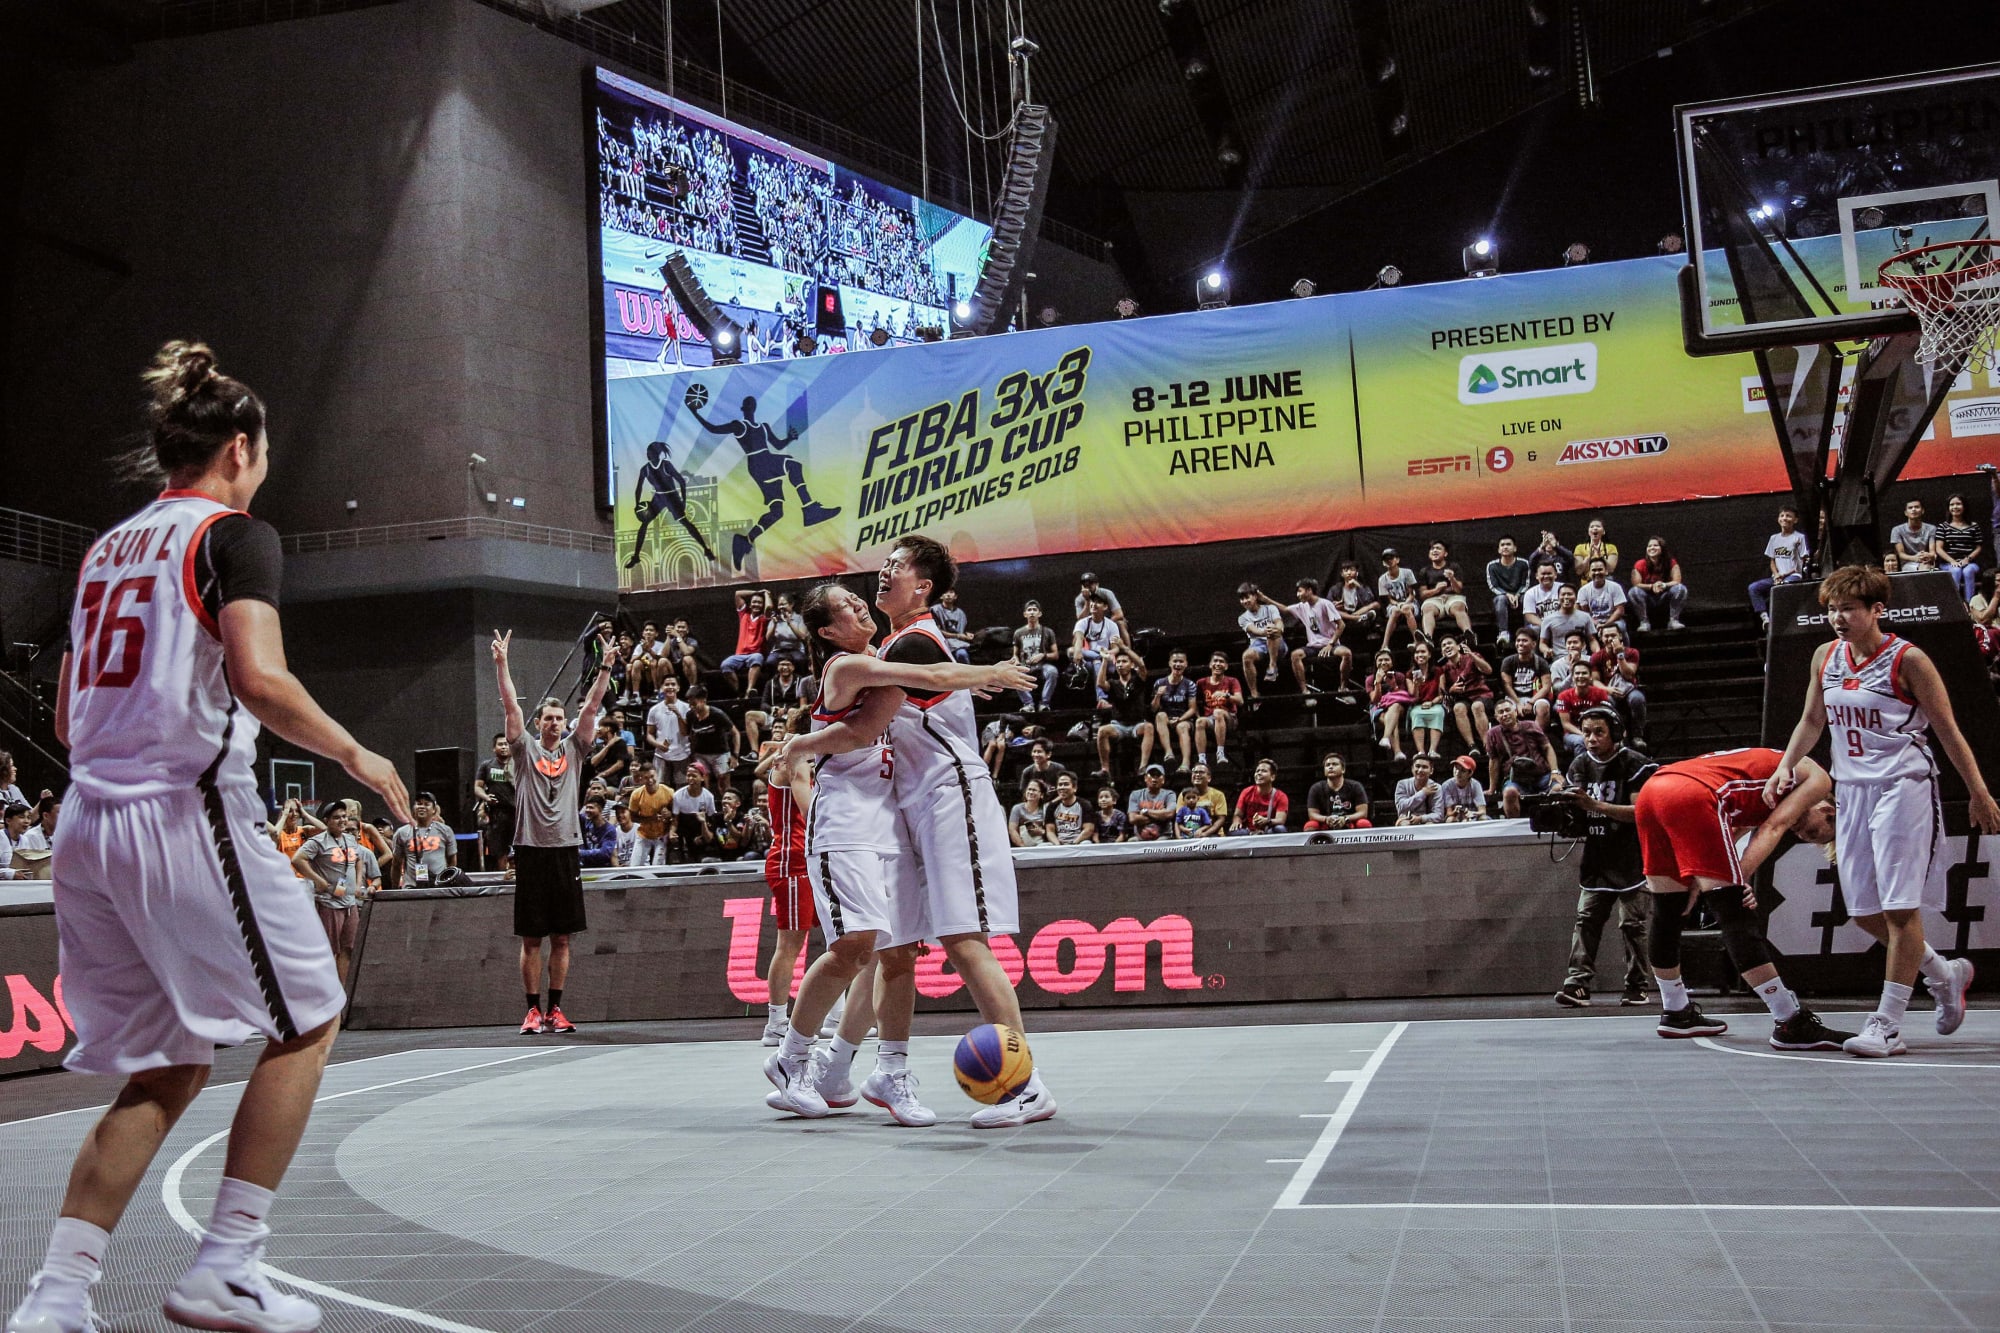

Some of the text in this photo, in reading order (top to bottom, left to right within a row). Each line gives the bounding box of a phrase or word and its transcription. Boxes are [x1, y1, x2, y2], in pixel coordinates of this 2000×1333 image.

[1431, 312, 1615, 350] PRESENTED BY
[1132, 370, 1303, 412] 8-12 JUNE
[1501, 358, 1586, 389] Smart
[862, 347, 1091, 480] FIBA 3x3
[1124, 402, 1317, 446] PHILIPPINE
[1502, 419, 1562, 436] LIVE ON
[858, 402, 1085, 519] WORLD CUP
[1169, 441, 1275, 475] ARENA
[1408, 455, 1471, 476] ESPN
[1493, 450, 1508, 469] 5
[1528, 451, 1537, 461] &
[856, 446, 1081, 551] PHILIPPINES 2018
[96, 527, 158, 568] SUN
[78, 576, 157, 691] 16
[1826, 705, 1882, 729] CHINA
[1846, 730, 1864, 757] 9
[1365, 833, 1415, 842] TIMEKEEPER
[1589, 826, 1605, 835] 012
